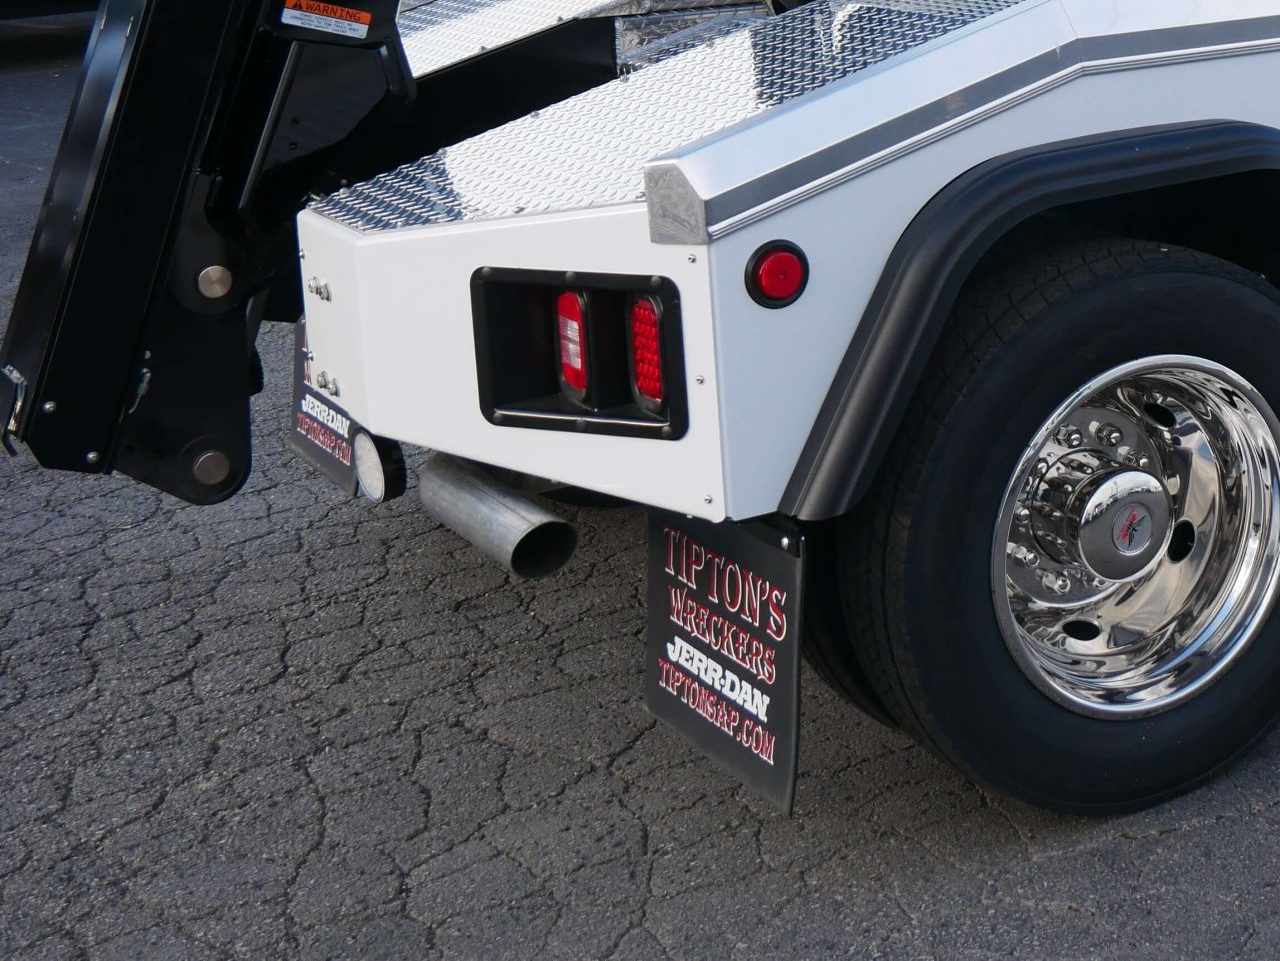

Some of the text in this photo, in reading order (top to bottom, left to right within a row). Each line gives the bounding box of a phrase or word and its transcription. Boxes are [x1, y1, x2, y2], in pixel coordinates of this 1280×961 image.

[306, 1, 361, 21] WARNING
[664, 527, 788, 641] TIPTON'S
[668, 585, 777, 685] WRECKERS
